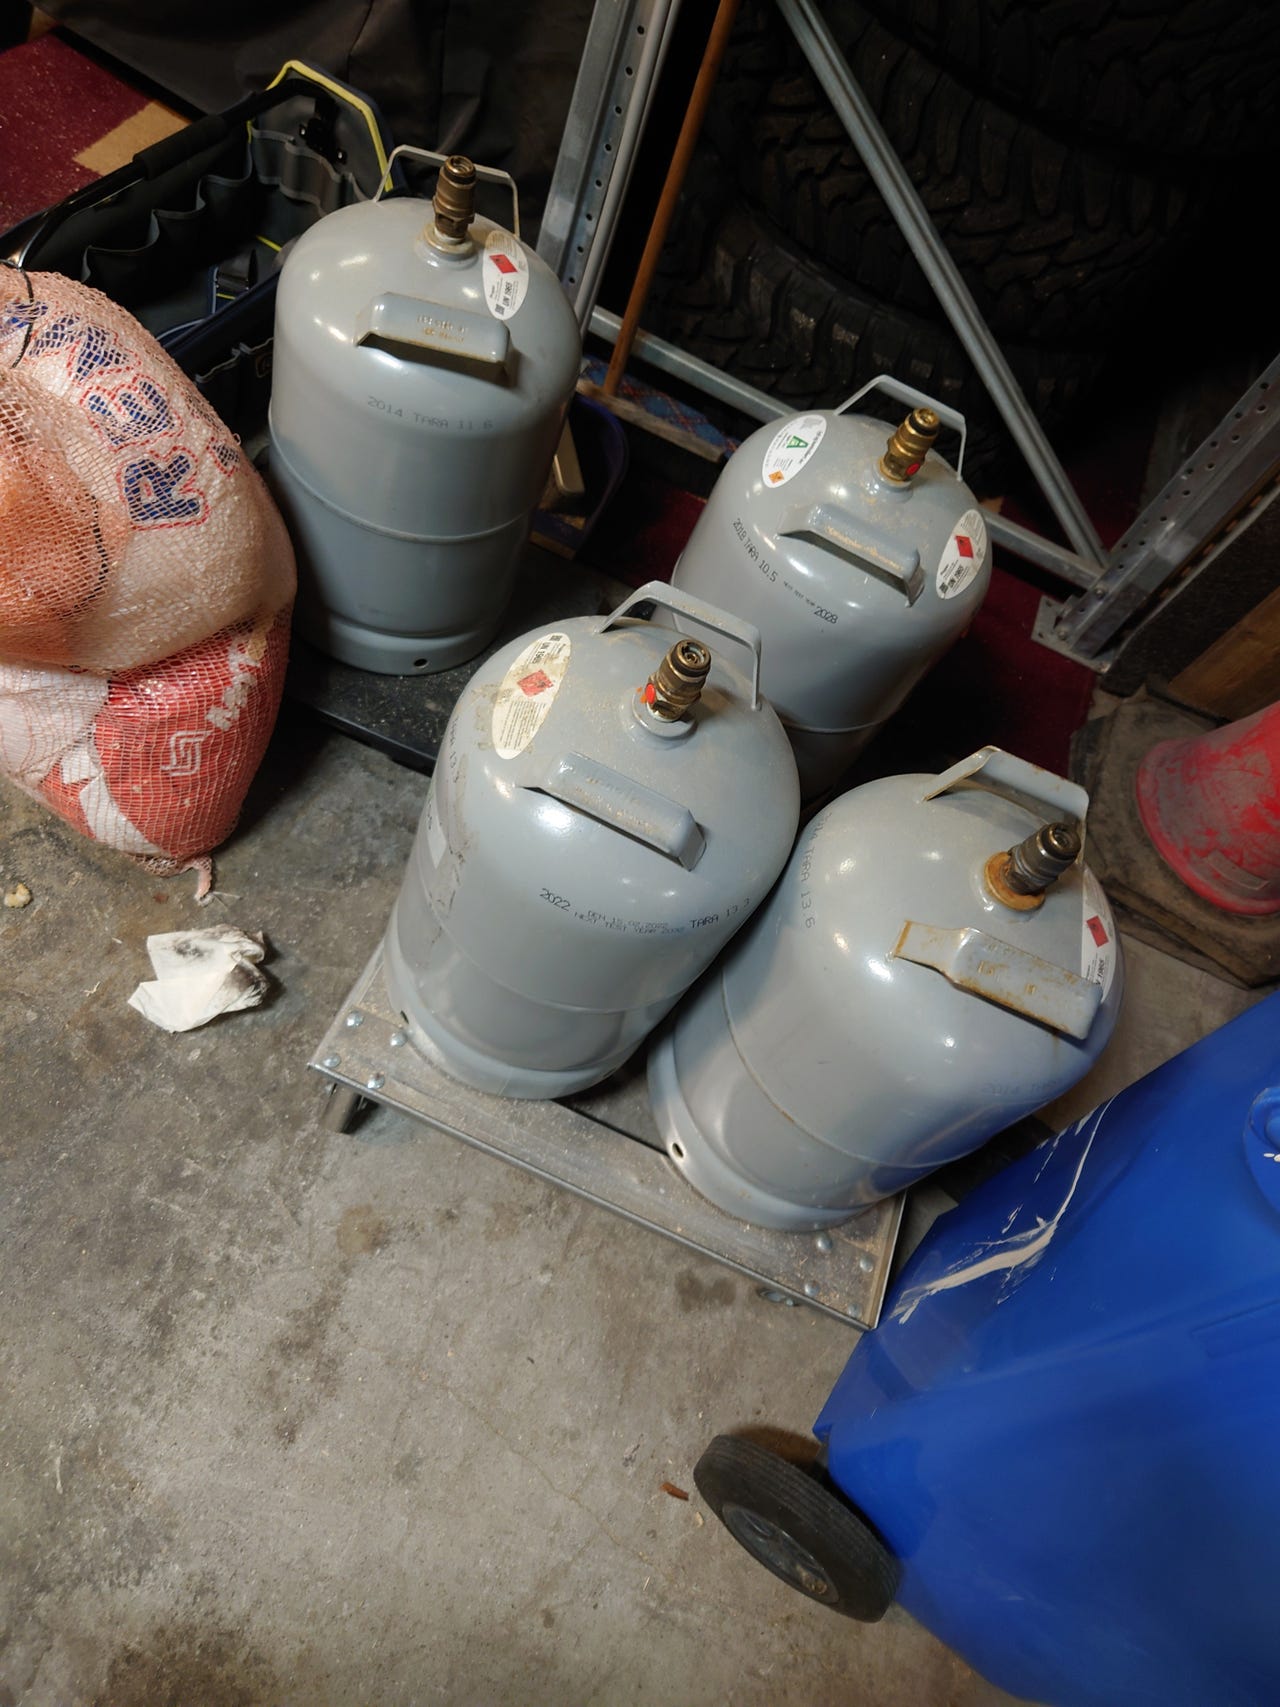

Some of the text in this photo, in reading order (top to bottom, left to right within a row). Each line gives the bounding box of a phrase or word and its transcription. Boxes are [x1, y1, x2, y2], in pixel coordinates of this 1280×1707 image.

[367, 395, 403, 417] 2014
[413, 412, 449, 429] TARA
[743, 539, 760, 561] TARA
[758, 560, 779, 583] 10.5
[814, 606, 839, 624] 2028
[539, 887, 571, 912] 2022
[690, 913, 719, 928] TARA
